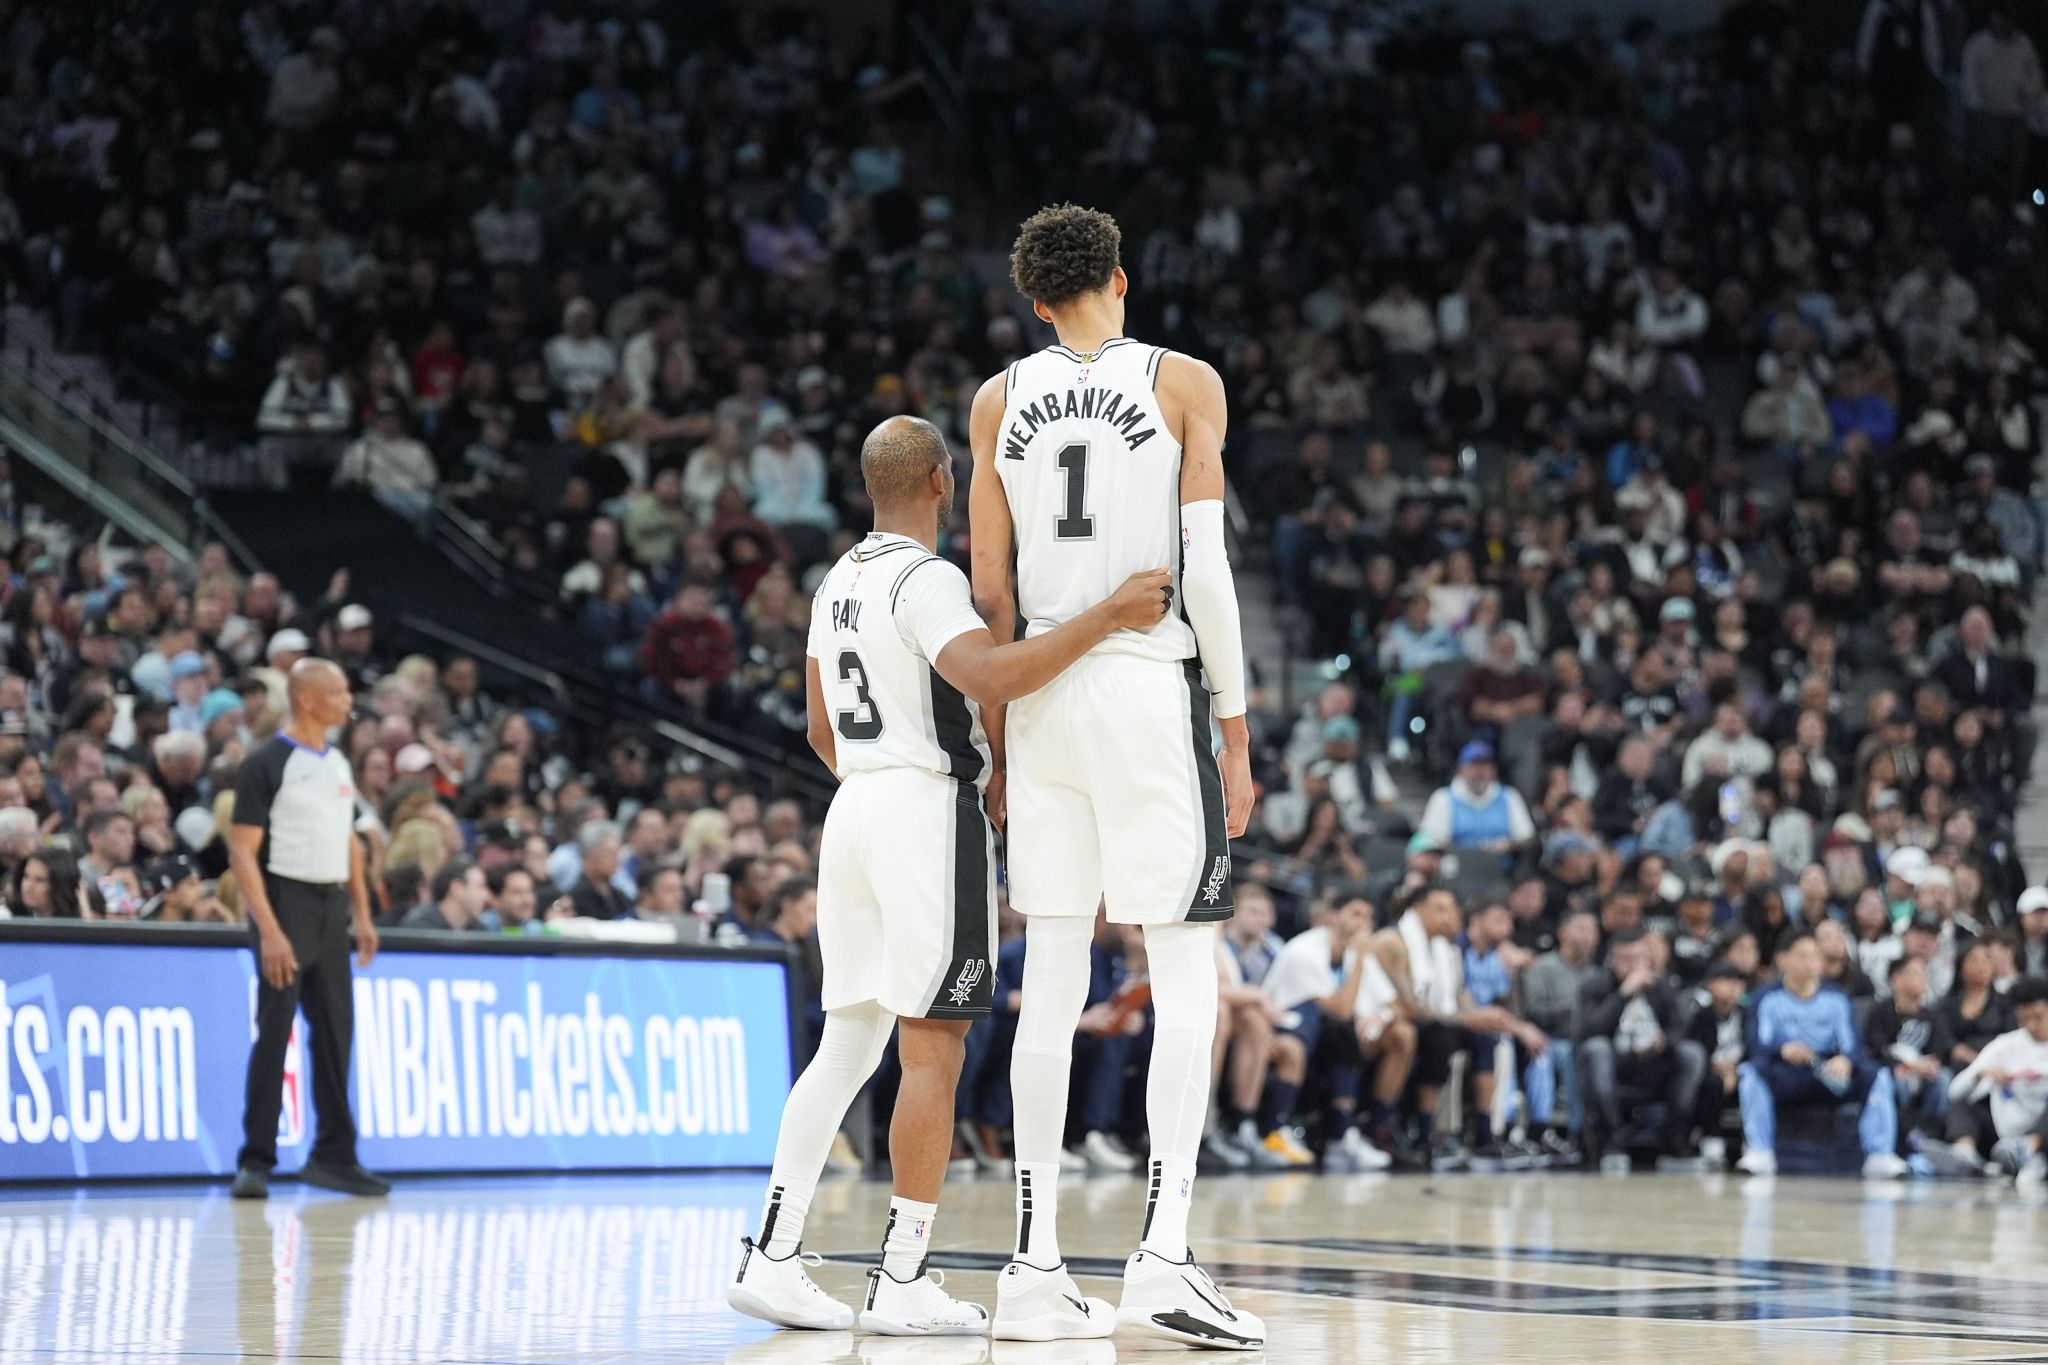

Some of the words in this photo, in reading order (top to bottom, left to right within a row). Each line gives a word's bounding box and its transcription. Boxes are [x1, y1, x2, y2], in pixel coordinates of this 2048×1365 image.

[1004, 387, 1157, 461] WEMBANYAMA
[1054, 440, 1096, 542] 1
[832, 598, 862, 633] PAUL
[835, 647, 886, 744] 3
[352, 976, 750, 1138] NBATickets.com
